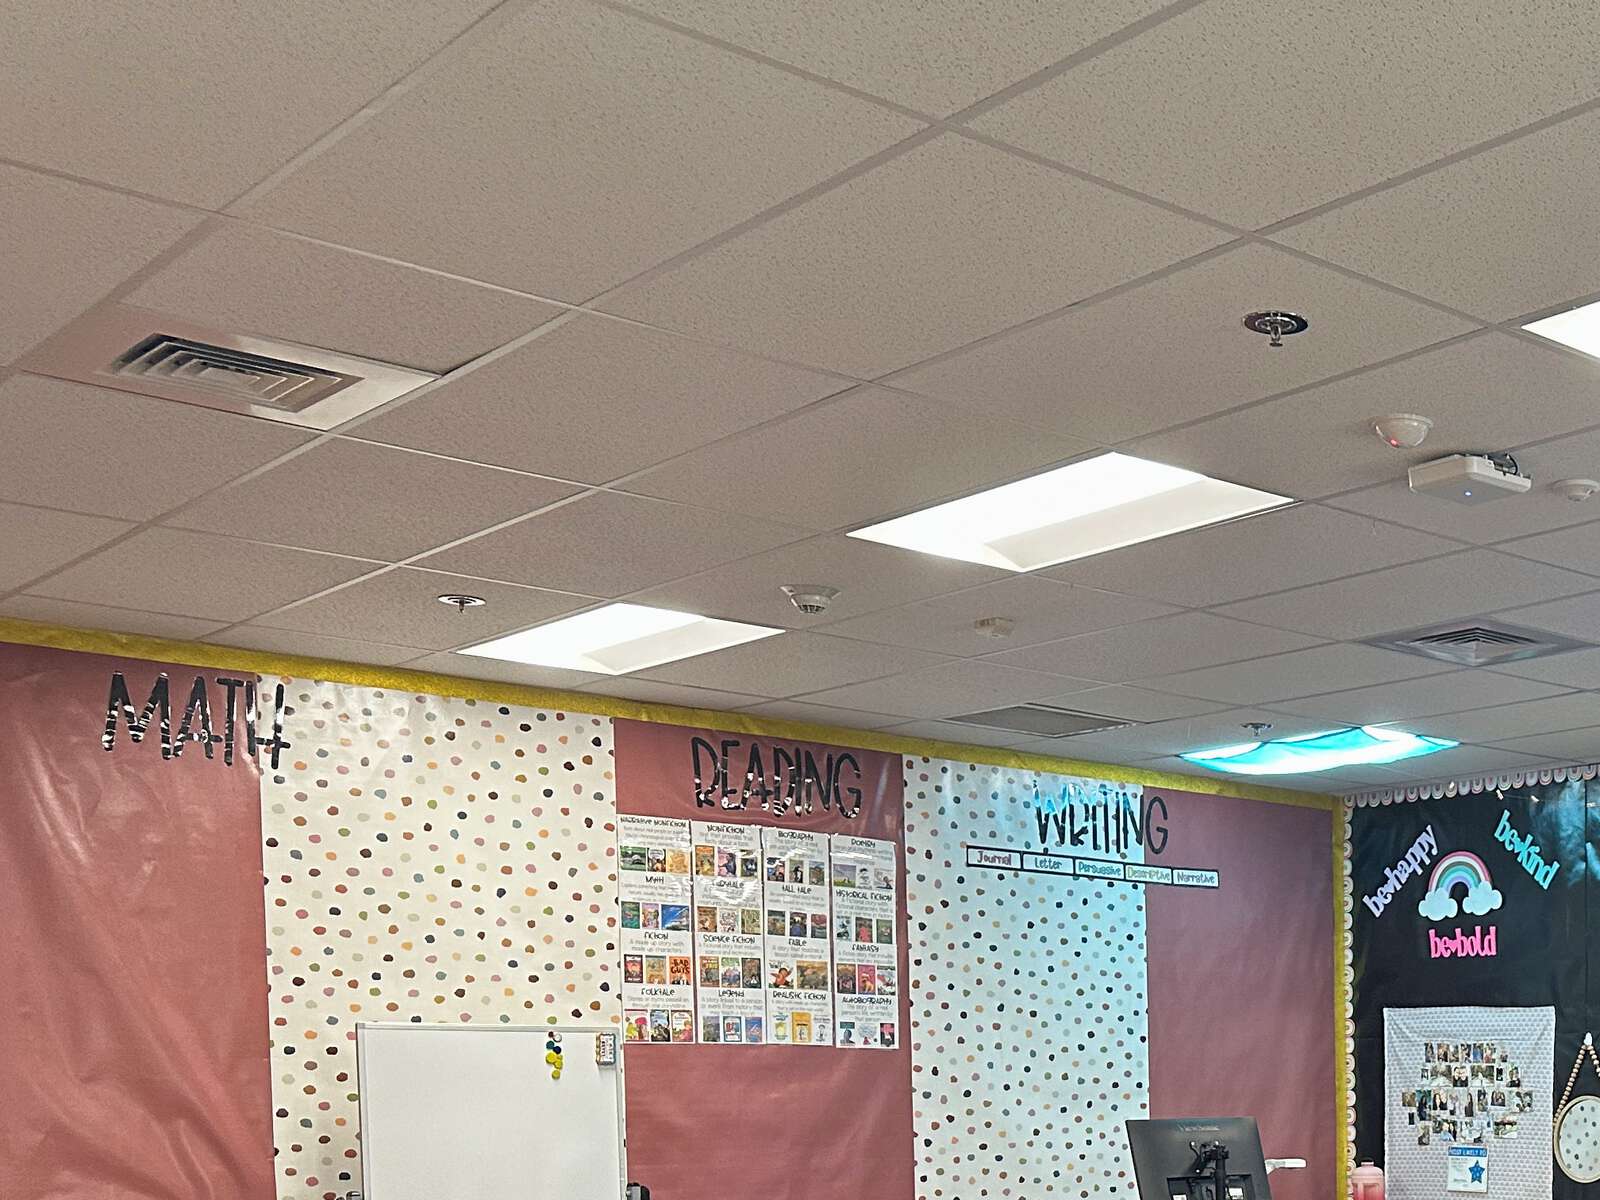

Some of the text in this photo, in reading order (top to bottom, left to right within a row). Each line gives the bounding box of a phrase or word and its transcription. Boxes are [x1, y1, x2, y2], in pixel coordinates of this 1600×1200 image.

[101, 671, 291, 769] MATH
[691, 737, 862, 818] READING
[1033, 780, 1168, 854] WRITING
[976, 850, 1012, 866] Journal
[1034, 857, 1063, 871] Letter
[1078, 862, 1122, 877] Persuasive
[1127, 866, 1170, 881] Descriptive
[1176, 871, 1216, 884] Narrative
